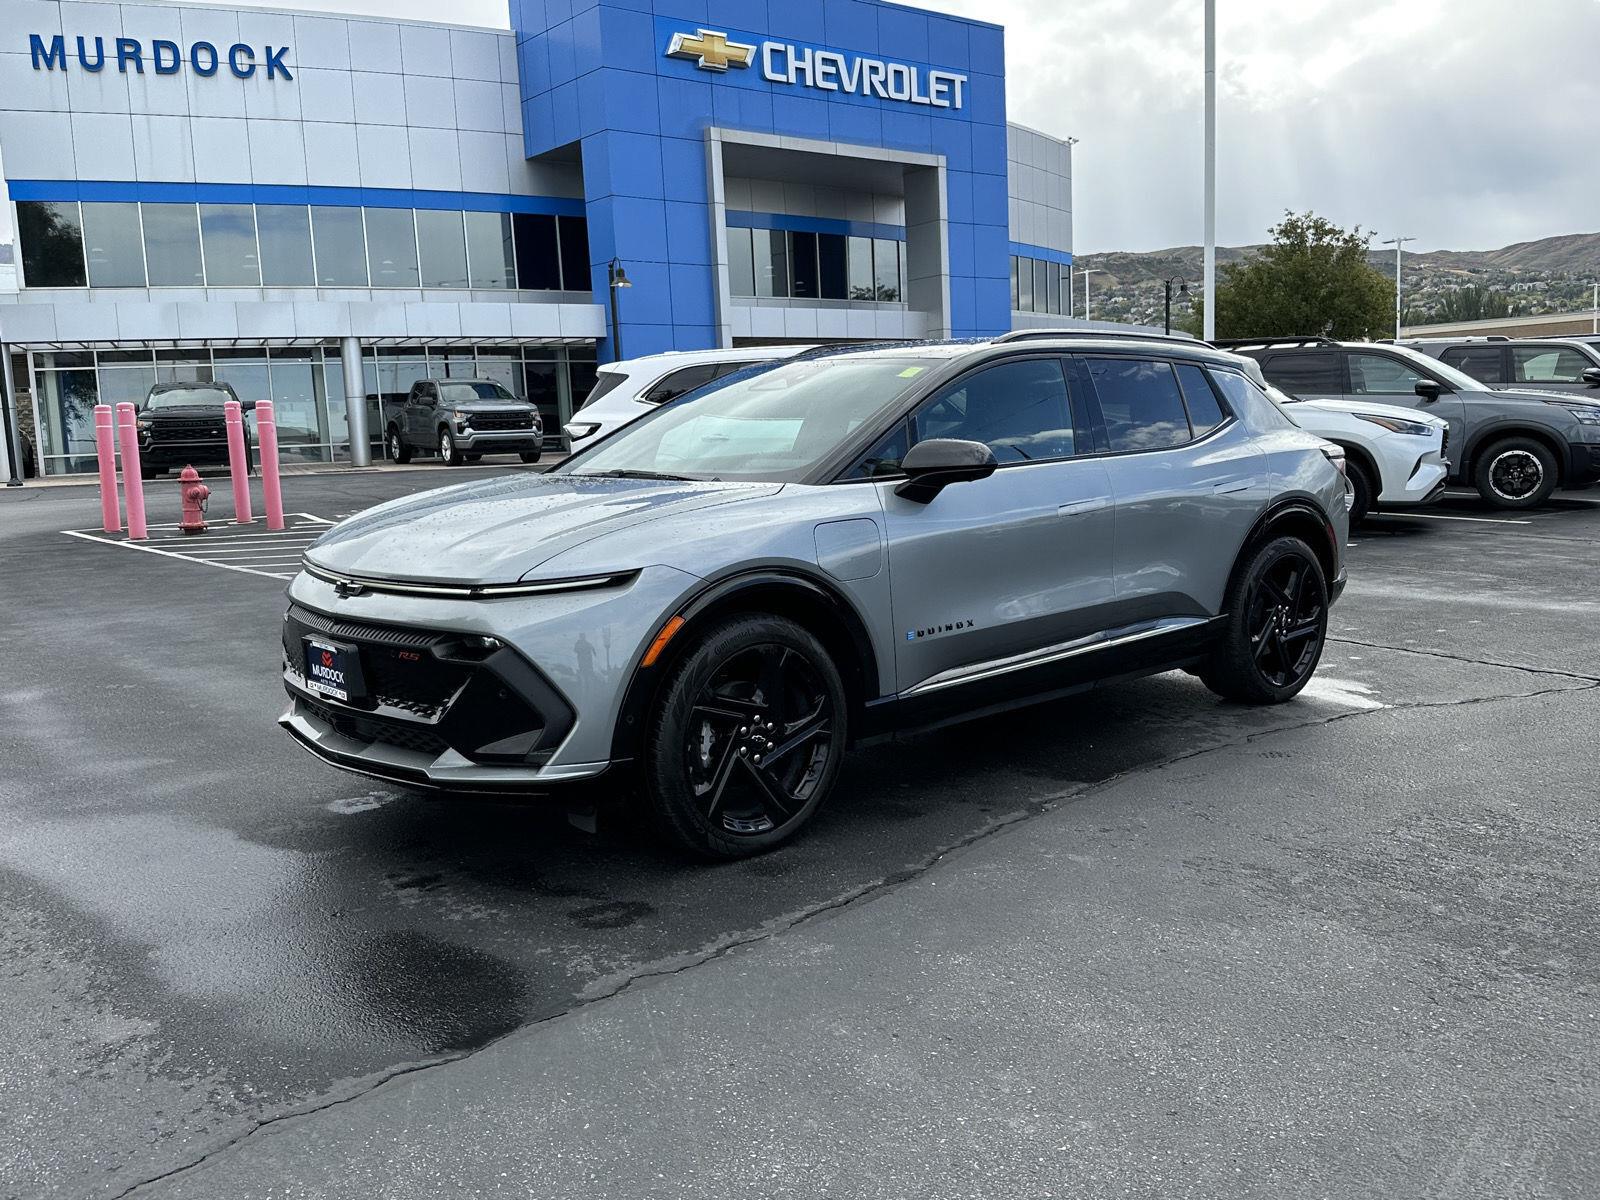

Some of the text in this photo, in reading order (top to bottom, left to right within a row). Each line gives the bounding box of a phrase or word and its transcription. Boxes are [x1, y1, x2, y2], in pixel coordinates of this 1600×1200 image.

[29, 33, 295, 81] MURDOCK
[762, 40, 968, 109] CHEVROLET
[906, 619, 975, 641] EQUINOX
[399, 651, 420, 661] RS
[311, 663, 345, 684] MURDOCK
